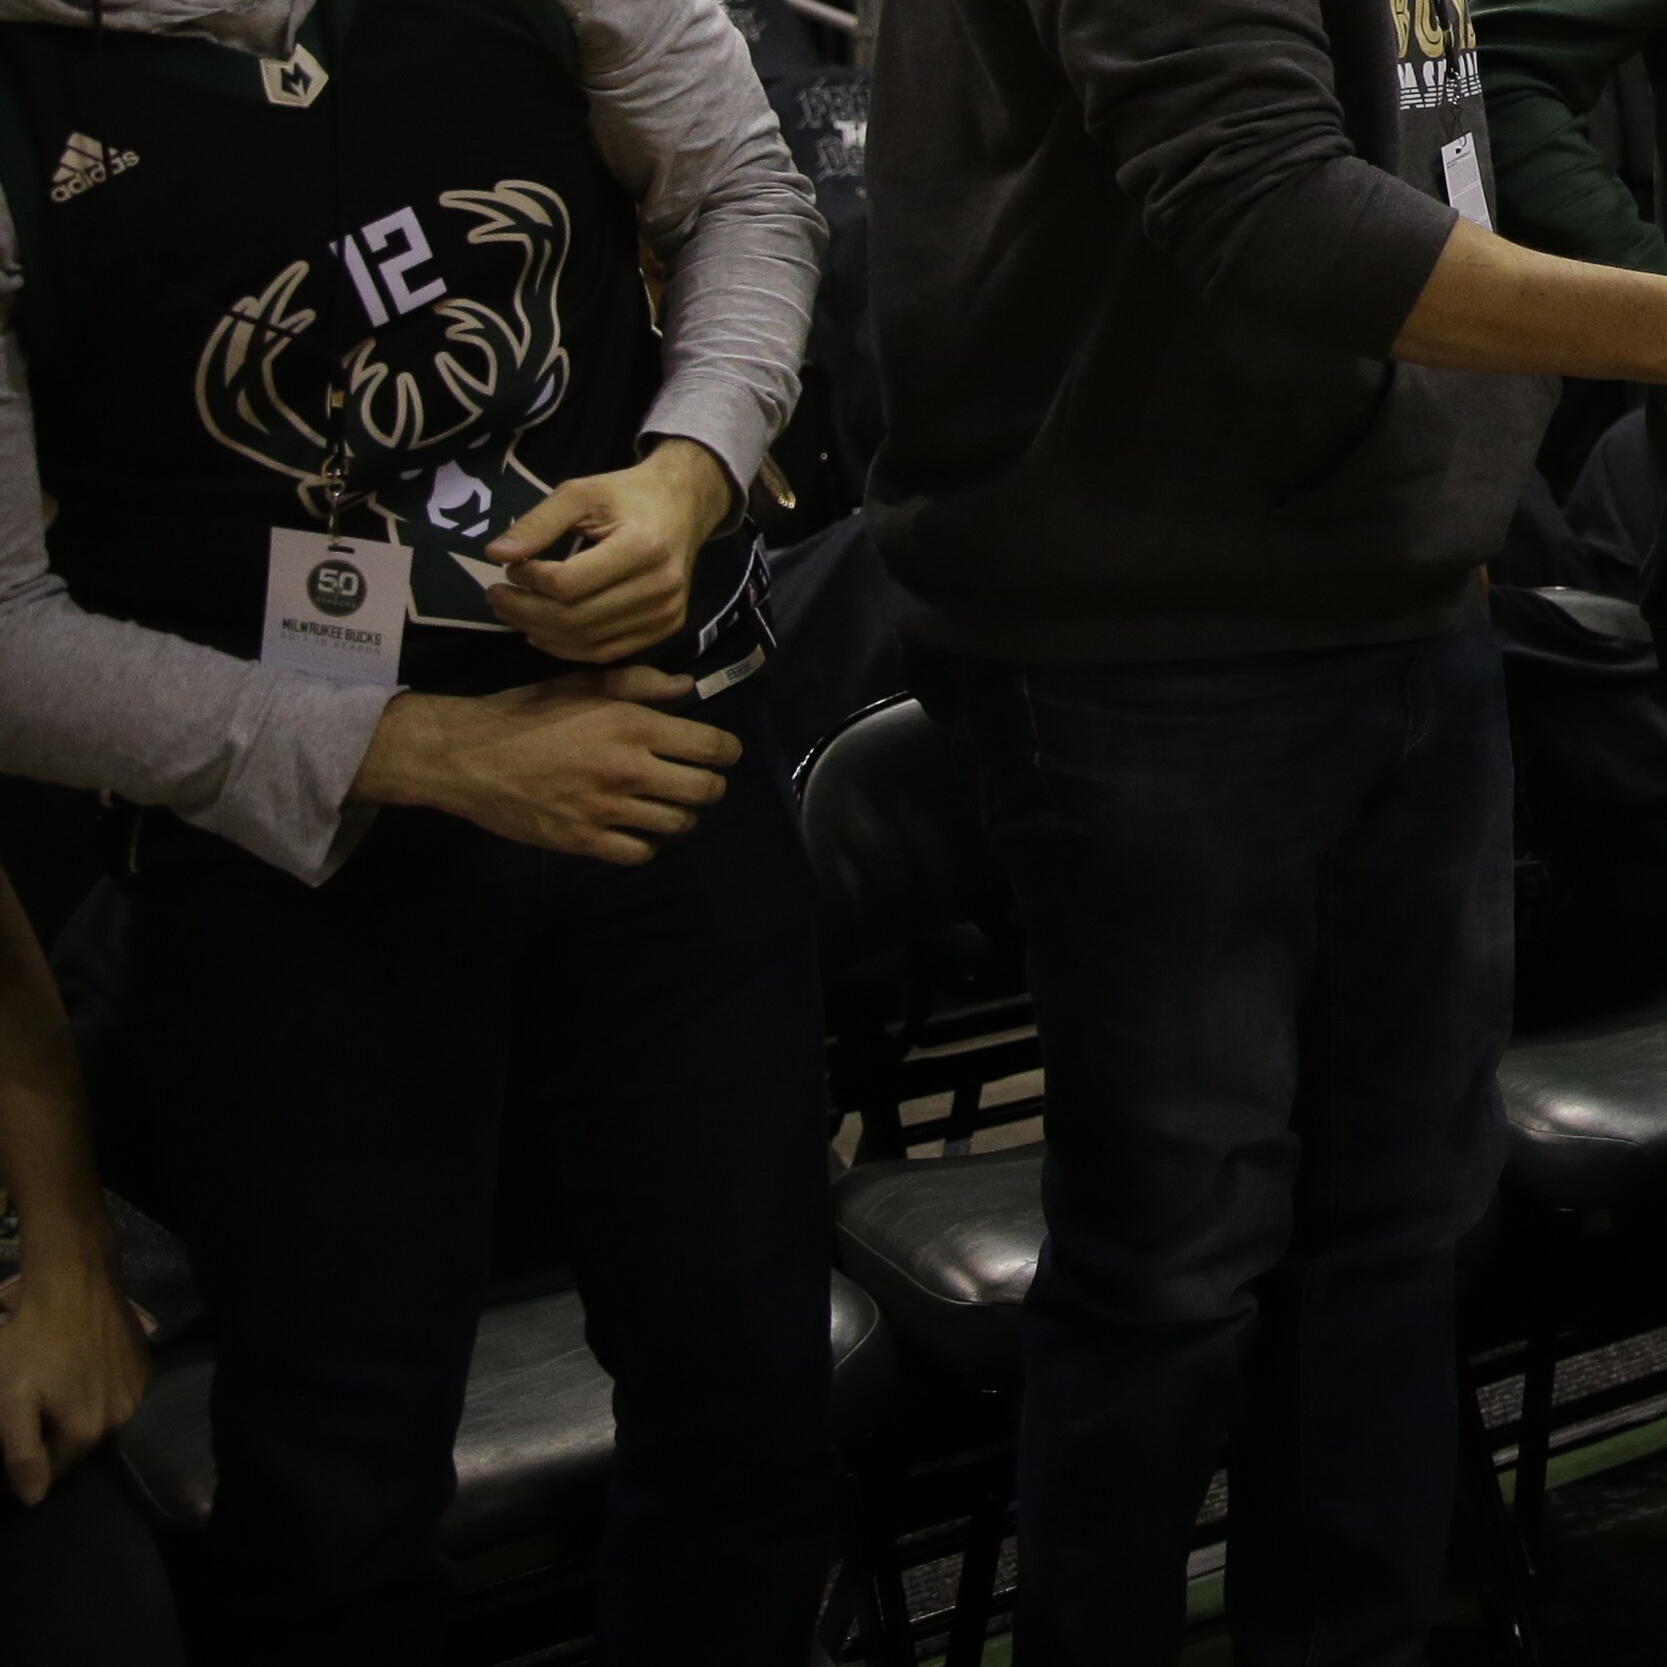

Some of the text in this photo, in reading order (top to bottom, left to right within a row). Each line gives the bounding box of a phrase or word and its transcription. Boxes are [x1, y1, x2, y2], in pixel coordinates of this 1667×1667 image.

[330, 205, 447, 329] 12
[317, 567, 361, 597] 50
[281, 617, 383, 647] MILWAUKEE BUCKS
